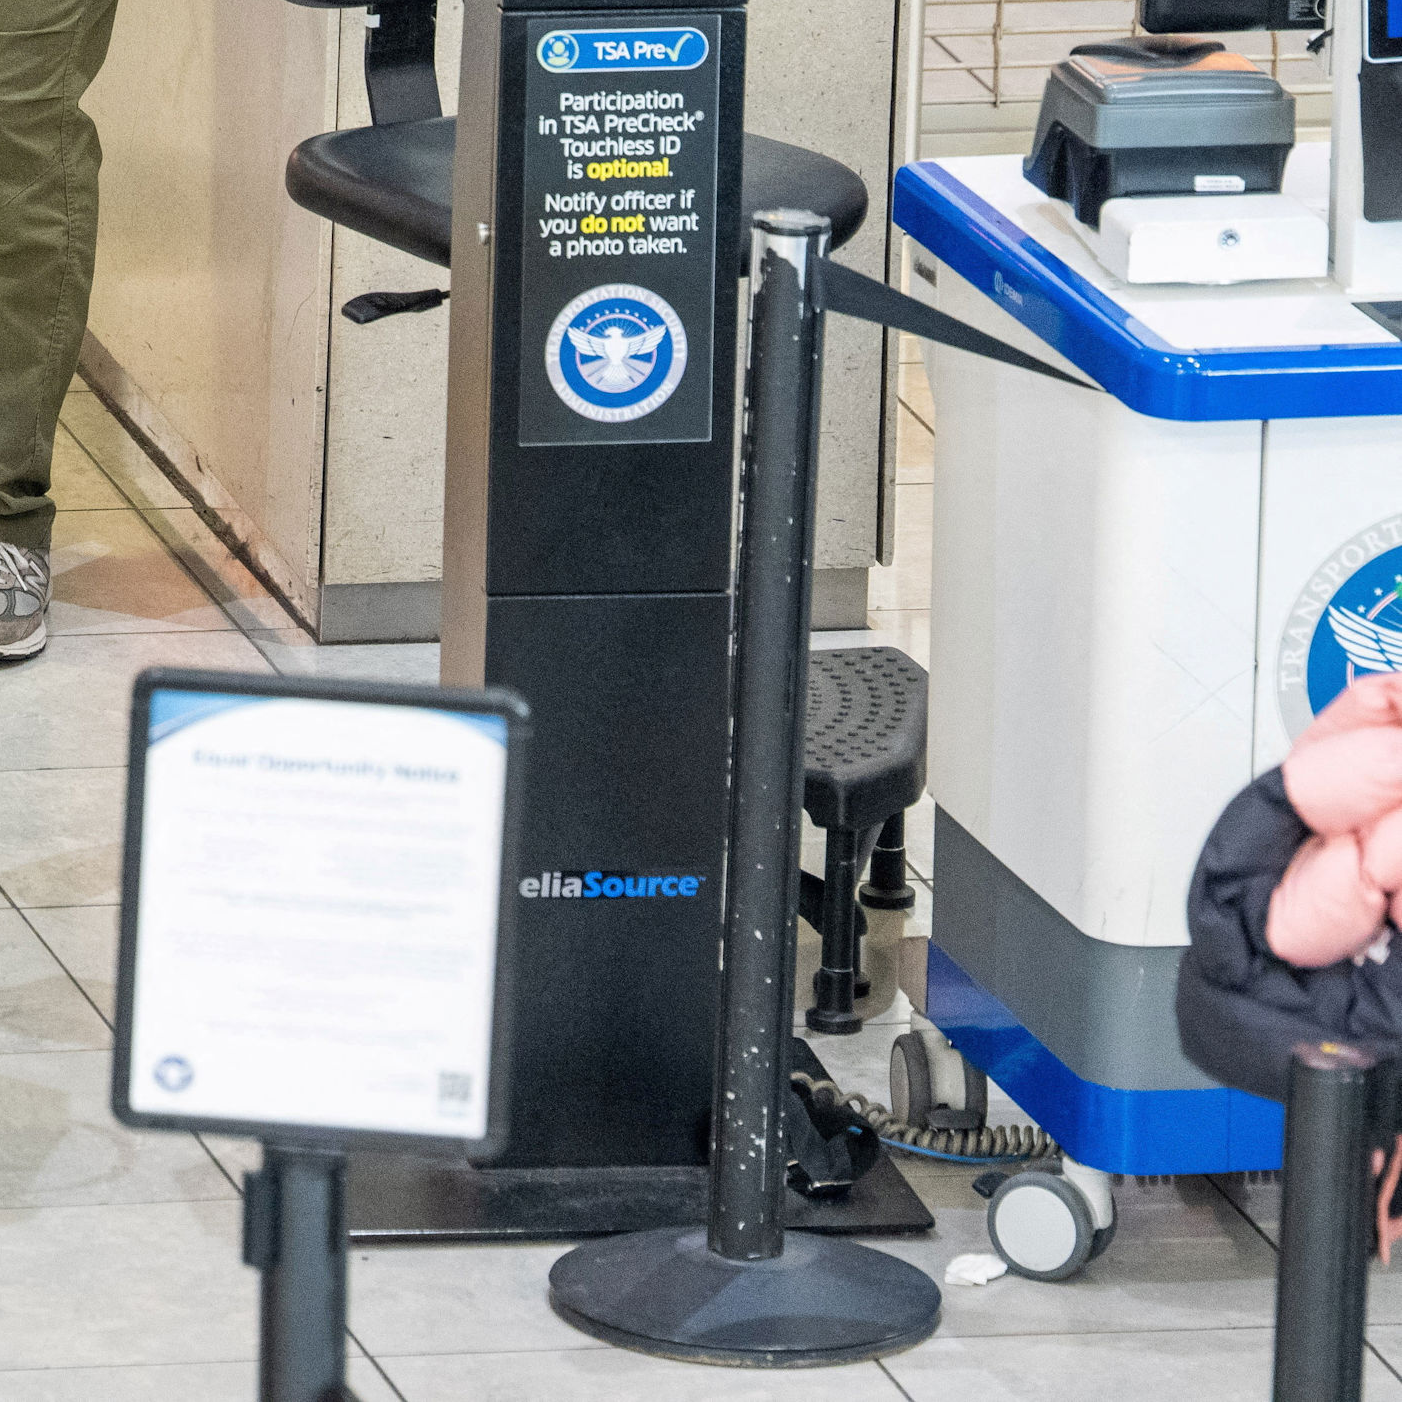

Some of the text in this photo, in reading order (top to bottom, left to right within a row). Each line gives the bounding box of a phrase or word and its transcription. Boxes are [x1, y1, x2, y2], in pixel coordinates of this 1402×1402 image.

[593, 41, 630, 61] TSA
[559, 89, 684, 113] Participation
[538, 115, 557, 135] in
[561, 114, 600, 135] TSA
[559, 135, 681, 158] Touchless ID
[567, 157, 674, 181] is optional.
[545, 189, 696, 214] Notify officer if
[539, 212, 699, 238] you do not want
[548, 234, 688, 259] a photo taken.
